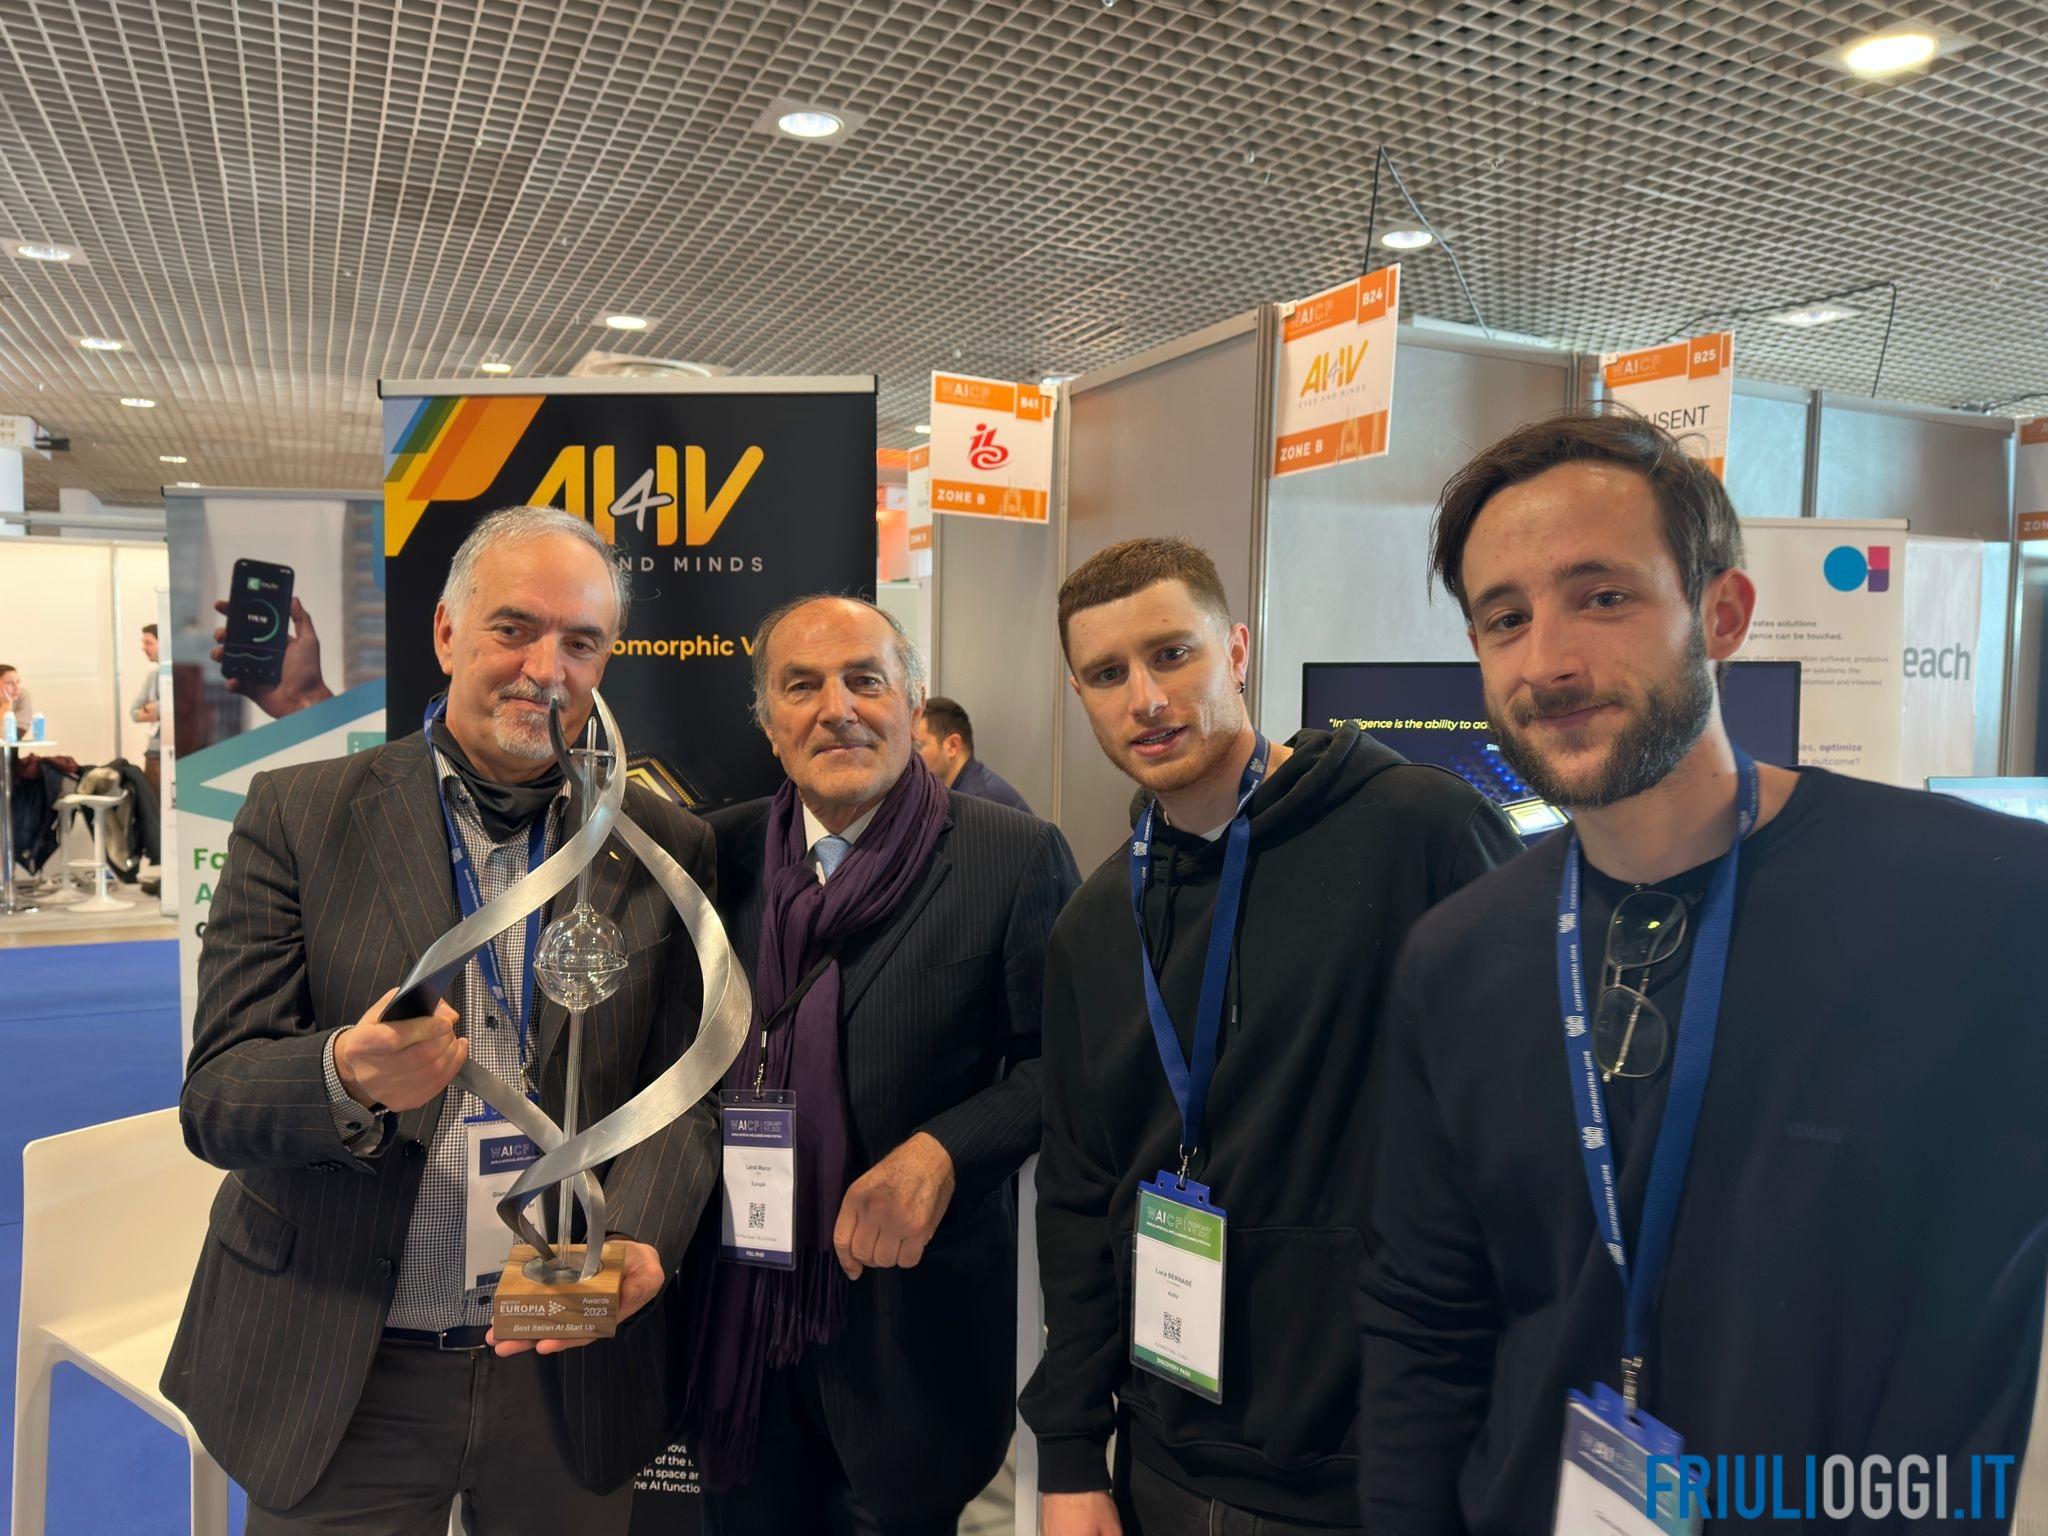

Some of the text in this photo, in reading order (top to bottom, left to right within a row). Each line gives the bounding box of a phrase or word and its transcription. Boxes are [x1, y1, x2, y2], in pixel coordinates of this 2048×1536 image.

[1362, 288, 1383, 307] B24
[1694, 349, 1716, 364] B25
[1280, 439, 1323, 461] ZONE B
[936, 488, 972, 504] ZONE
[977, 492, 986, 504] B
[674, 556, 763, 572] MINDS
[1793, 632, 1804, 640] be
[1394, 718, 1403, 729] is
[1405, 719, 1423, 729] the
[1424, 719, 1458, 731] ability
[1459, 719, 1471, 729] to
[1819, 742, 1862, 753] optimize
[1155, 1267, 1167, 1277] Luca
[500, 1304, 546, 1313] EUROPIA
[583, 1307, 608, 1317] 2023
[513, 1324, 530, 1332] Best
[584, 1324, 595, 1332] Up
[655, 1454, 666, 1465] of
[668, 1456, 686, 1466] the
[656, 1469, 687, 1480] space
[649, 1480, 660, 1491] AI
